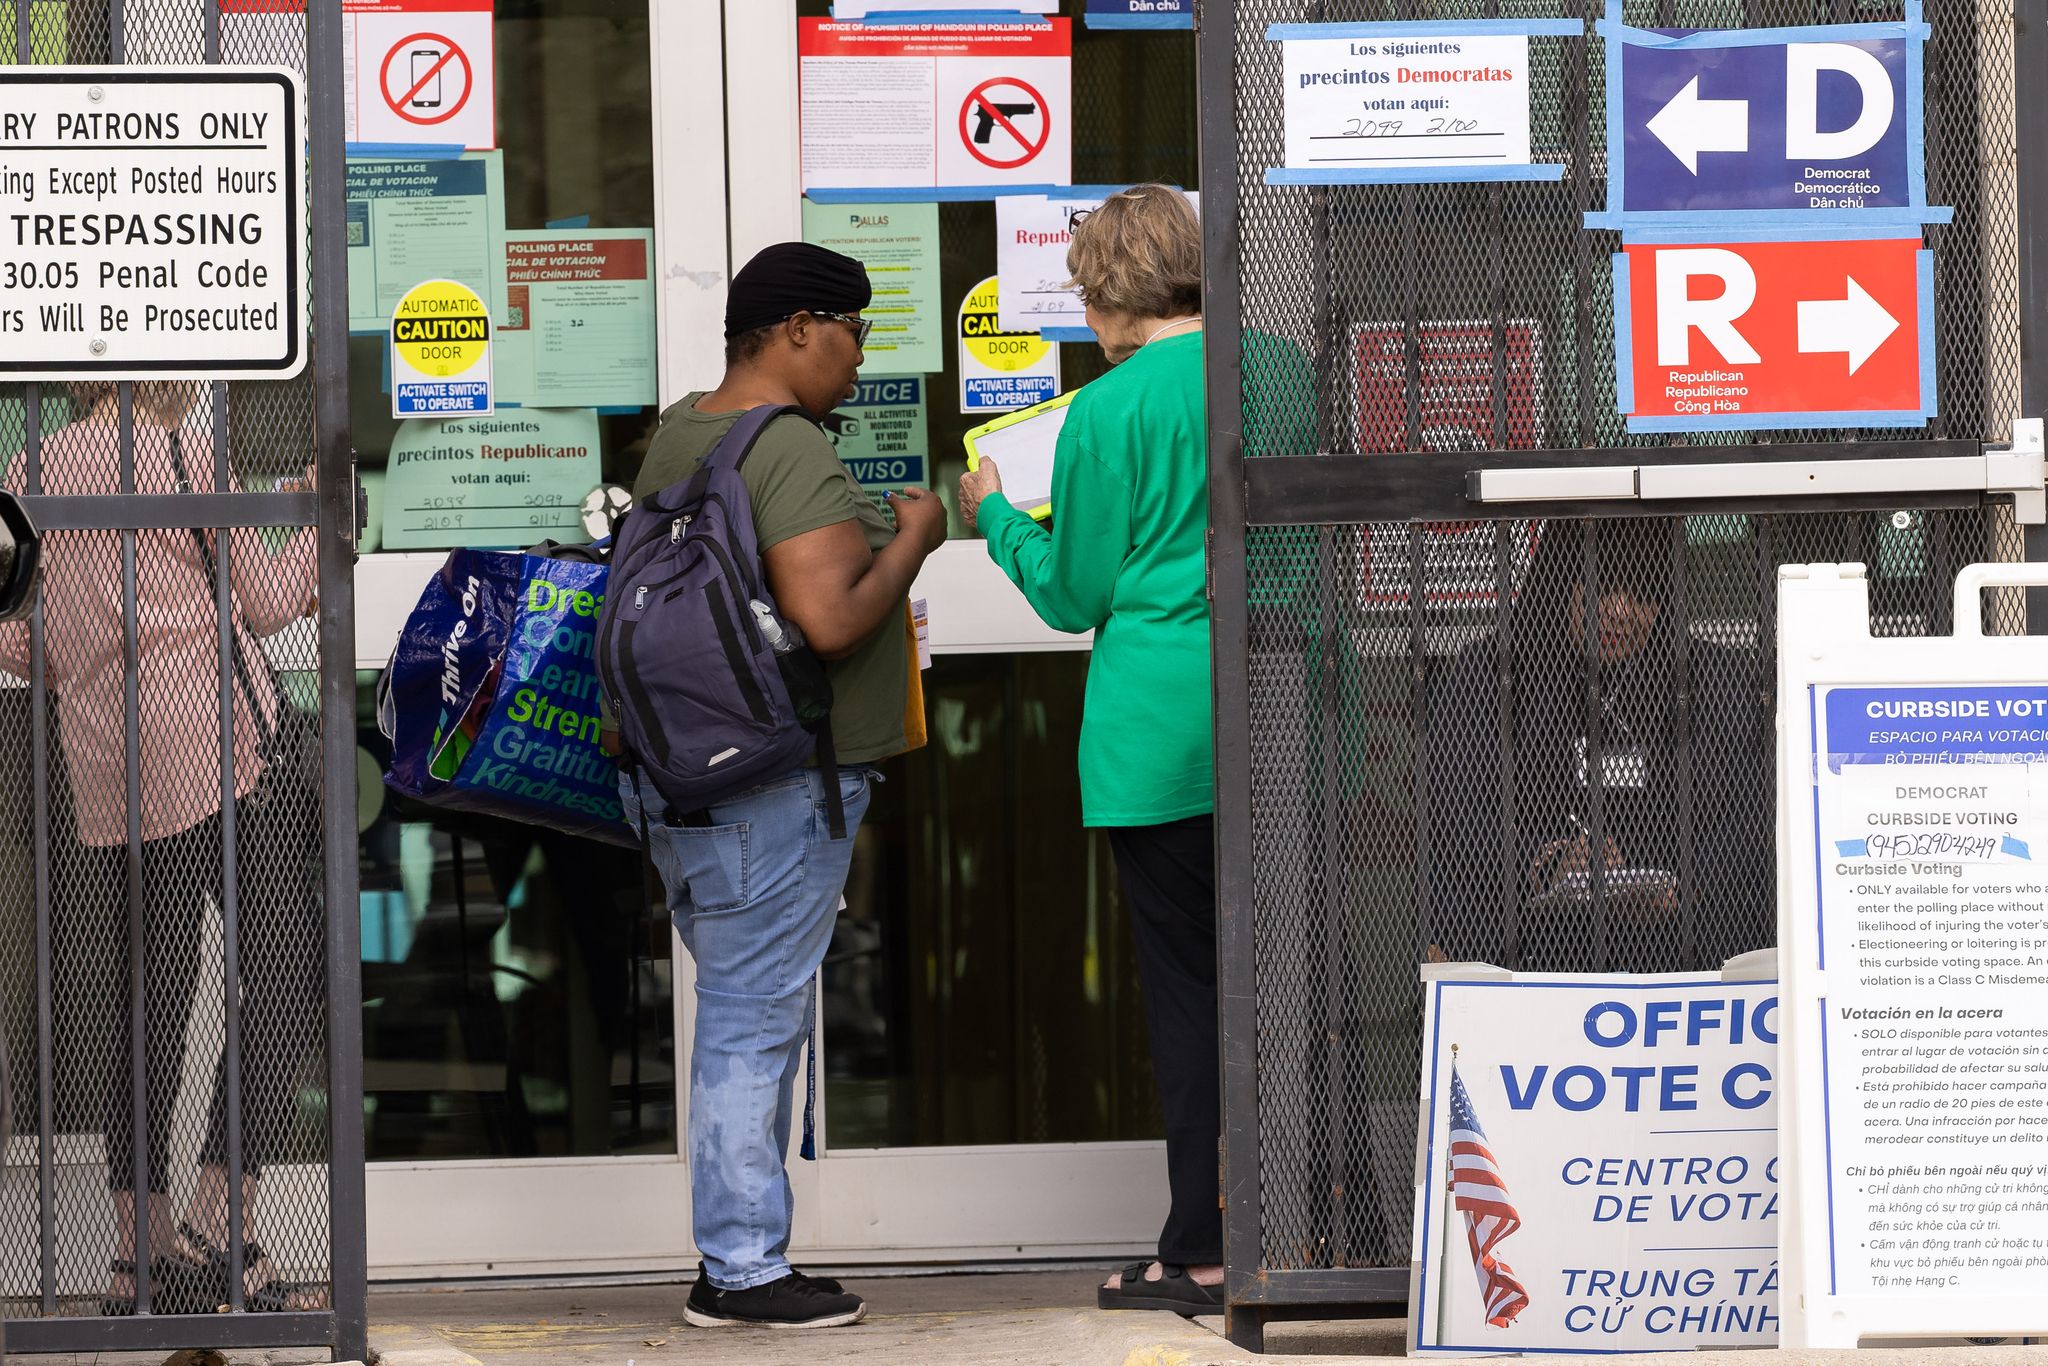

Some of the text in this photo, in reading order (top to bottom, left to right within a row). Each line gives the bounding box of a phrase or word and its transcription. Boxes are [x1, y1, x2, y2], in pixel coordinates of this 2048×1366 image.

[1350, 41, 1461, 58] Los siguientes
[1300, 67, 1512, 88] precintos Democratas
[1363, 97, 1449, 113] votan aquí:
[1786, 43, 1894, 159] D
[0, 112, 268, 140] RY PATRONS ONLY
[1343, 117, 1477, 137] 2099 2100
[349, 164, 427, 174] POLLING PLACE
[1805, 166, 1870, 179] Democrat
[50, 167, 117, 201] Except
[131, 165, 201, 194] Posted
[217, 166, 277, 193] Hours
[370, 177, 384, 186] DE
[386, 176, 438, 186] VOTACION
[1794, 181, 1880, 195] Democrático
[1810, 196, 1864, 208] Dân chủ
[11, 213, 262, 246] TRESPASSING
[508, 243, 594, 253] POLLING PLACE
[531, 257, 546, 266] DE
[550, 256, 606, 265] VOTACION
[4, 259, 268, 289] 30.05 Penal Code
[402, 299, 478, 313] AUTOMATIC
[1655, 248, 1762, 366] R
[40, 303, 84, 332] Will
[100, 305, 128, 332] Be
[145, 303, 278, 331] Prosecuted
[570, 319, 584, 327] 32
[397, 320, 484, 340] CAUTION
[421, 347, 462, 360] DOOR
[989, 341, 1029, 354] DOOR
[967, 378, 1053, 392] ACTIVATE SWITCH
[1669, 371, 1743, 386] Republican
[399, 384, 486, 397] ACTIVATE SWITCH
[845, 382, 912, 403] OTICE
[1665, 386, 1748, 401] Republicano
[413, 397, 474, 410] TO OPERATE
[980, 391, 1041, 405] TO OPERATE
[864, 409, 918, 419] ALL ACTIVITIES
[1674, 401, 1740, 417] Cộng Hòa
[441, 422, 540, 435] Los siguientes
[870, 421, 912, 430] MONITORED
[887, 431, 908, 440] VIDEO
[398, 443, 588, 465] precintos Republicano
[876, 443, 907, 452] CAMERA
[452, 471, 531, 485] votan aquí:
[441, 575, 480, 706] Thrive On
[522, 614, 595, 658] Con
[1866, 700, 1989, 718] CURBSIDE
[507, 688, 603, 746] Stren
[1869, 729, 2048, 743] ESPACIO PARA VOTACI
[1896, 787, 1988, 799] DEMOCRAT
[1867, 812, 2018, 825] CURBSIDE VOTING
[1835, 863, 1963, 877] Curbside Voting
[1857, 883, 2042, 895] ONLY available for voters who
[1858, 901, 2044, 914] enter the polling place without
[1841, 1007, 2003, 1019] Votación en la acera
[1500, 1062, 1772, 1112] VOTE C
[1561, 1156, 1748, 1186] CENTRO
[1925, 1166, 1946, 1176] bên
[1950, 1165, 1982, 1177] ngoài
[2012, 1165, 2032, 1176] quý
[1593, 1194, 1652, 1222] DE
[1562, 1269, 1715, 1298] TRUNG
[1565, 1297, 1634, 1334] CỬ
